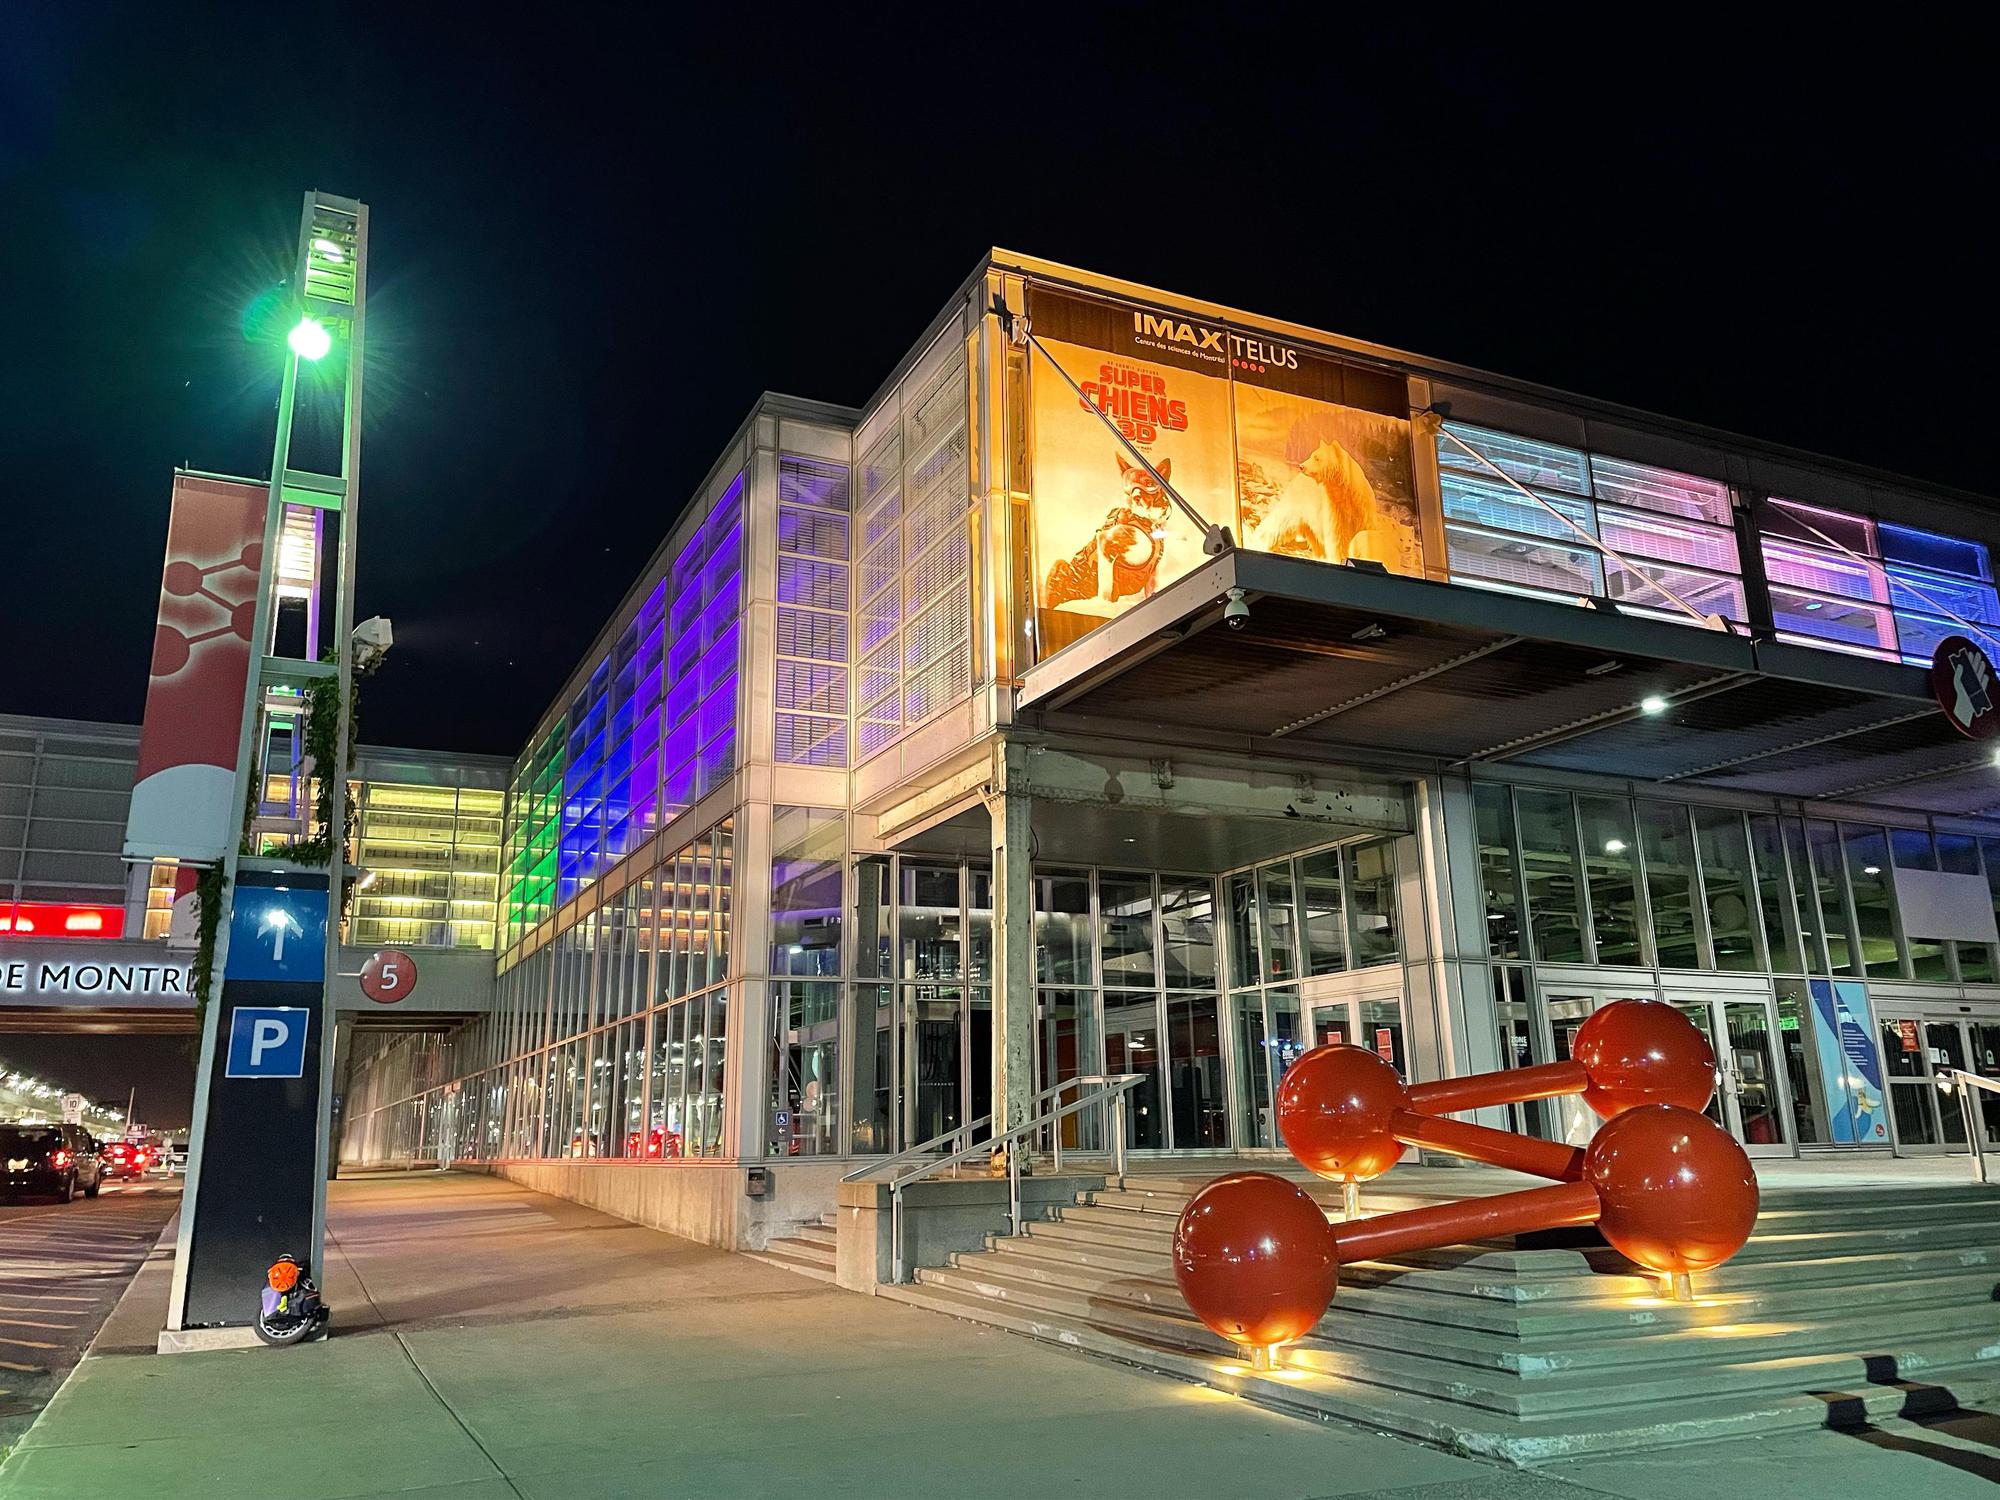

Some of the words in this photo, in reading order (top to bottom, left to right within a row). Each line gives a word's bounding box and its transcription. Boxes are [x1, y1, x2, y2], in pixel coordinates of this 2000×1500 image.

[1134, 312, 1224, 353] IMAX
[1230, 334, 1298, 370] TELUS
[1134, 336, 1156, 347] Centre
[1156, 341, 1167, 350] des
[1167, 345, 1191, 355] sciences
[1191, 350, 1199, 358] de
[1099, 364, 1167, 397] SUPER
[1079, 380, 1189, 432] CHIENS
[1116, 419, 1157, 444] 3D
[0, 964, 25, 988] E
[381, 964, 398, 990] 5
[250, 1018, 289, 1066] P
[69, 1100, 77, 1108] 10
